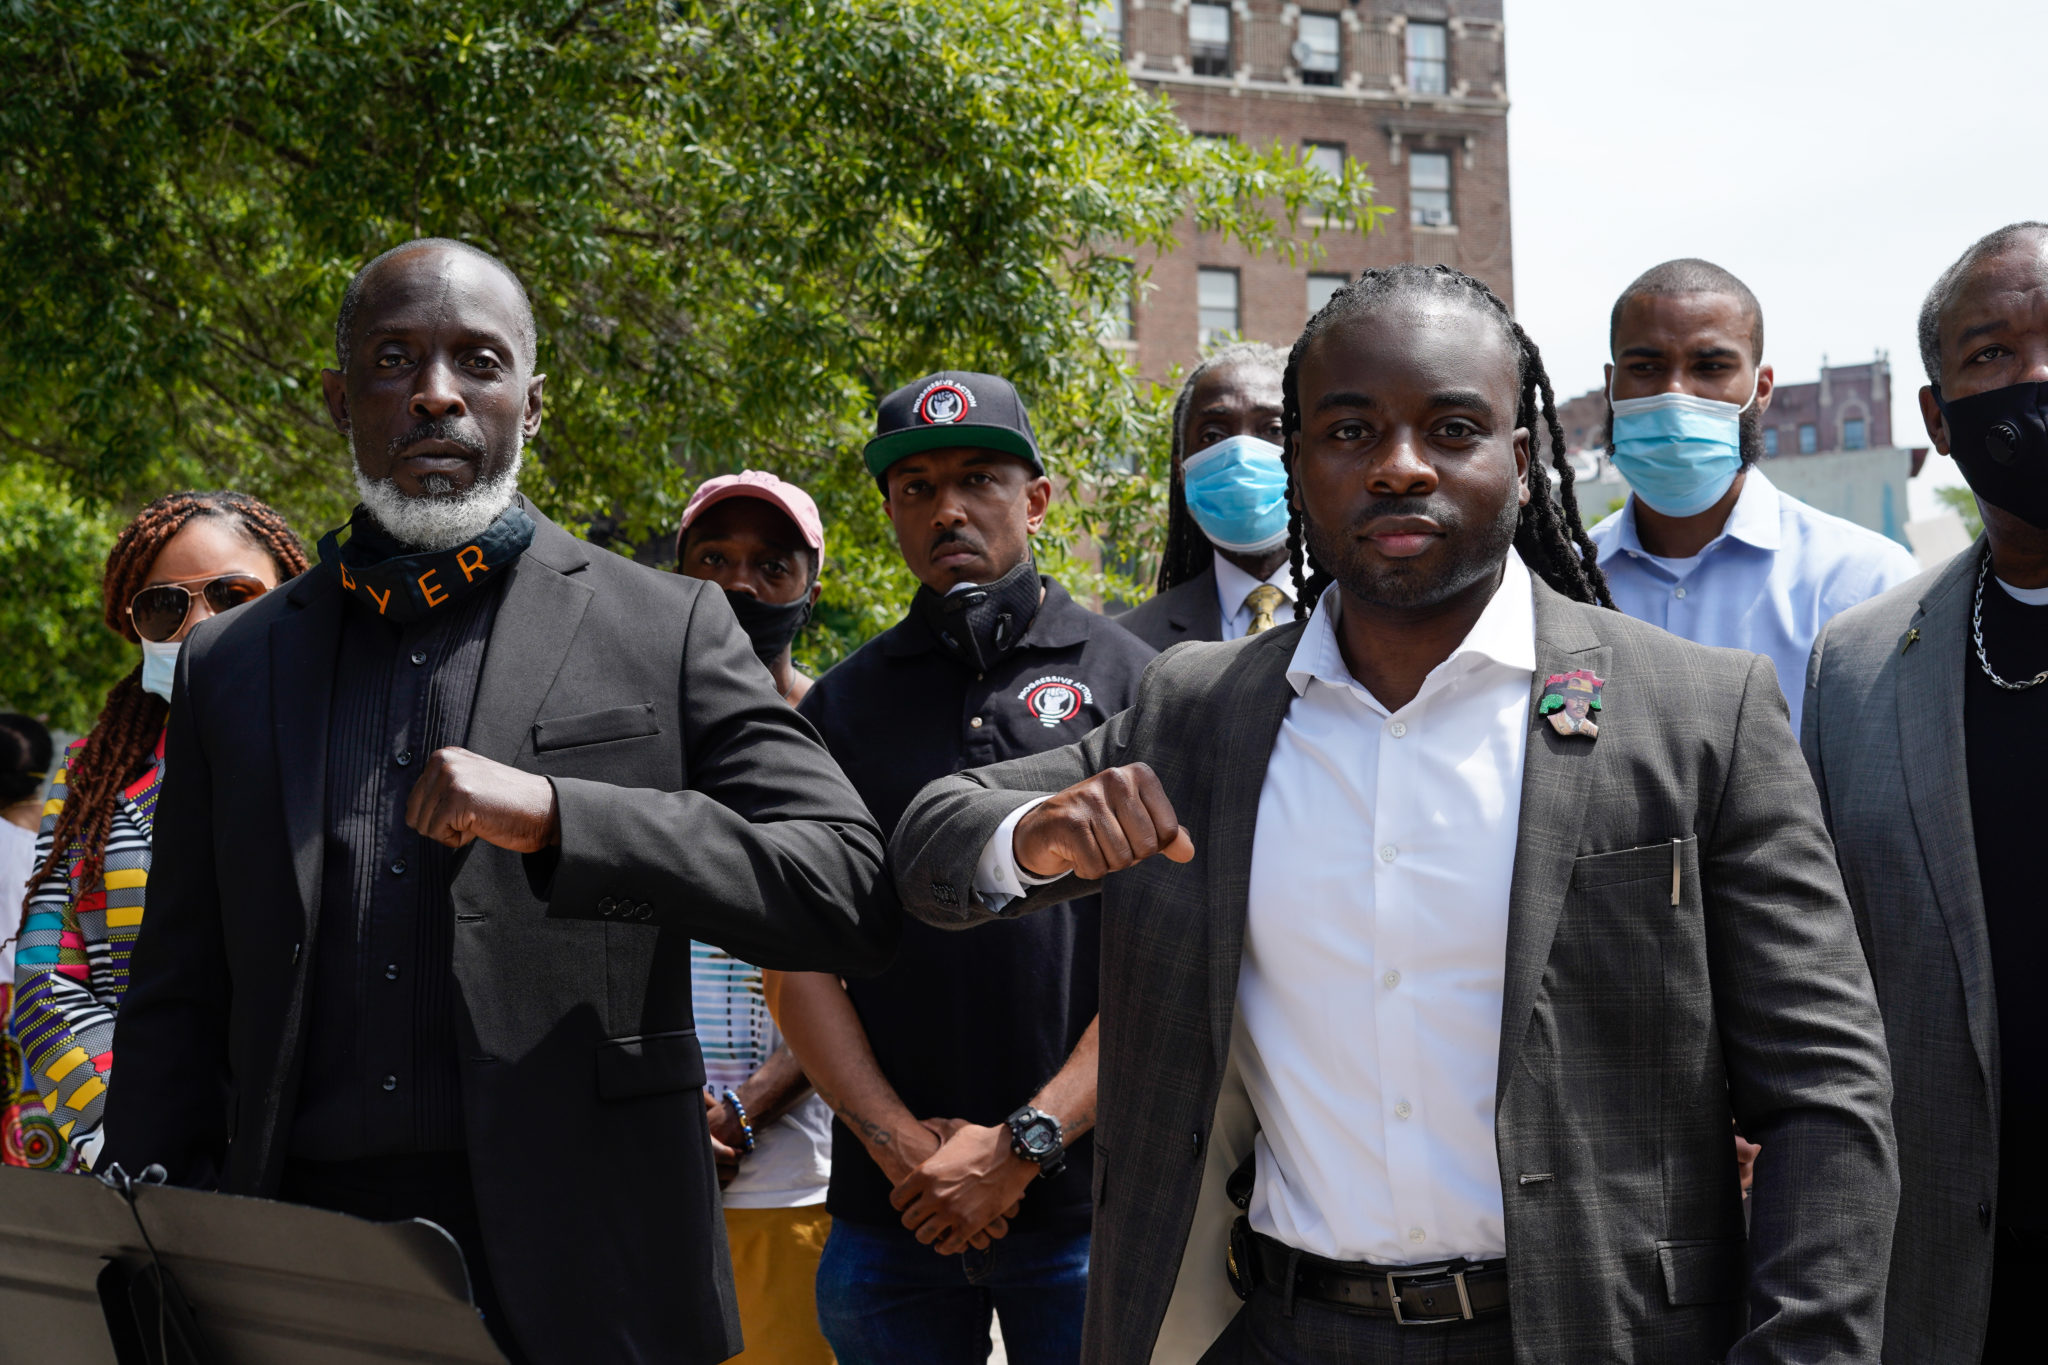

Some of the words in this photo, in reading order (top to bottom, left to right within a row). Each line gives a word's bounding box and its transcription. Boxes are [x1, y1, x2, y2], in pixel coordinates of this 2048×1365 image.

[912, 379, 954, 413] PROGRESSIVE
[954, 383, 977, 407] ACTION
[1017, 675, 1073, 700] PROGRESSIVE
[1073, 682, 1093, 704] ACTION
